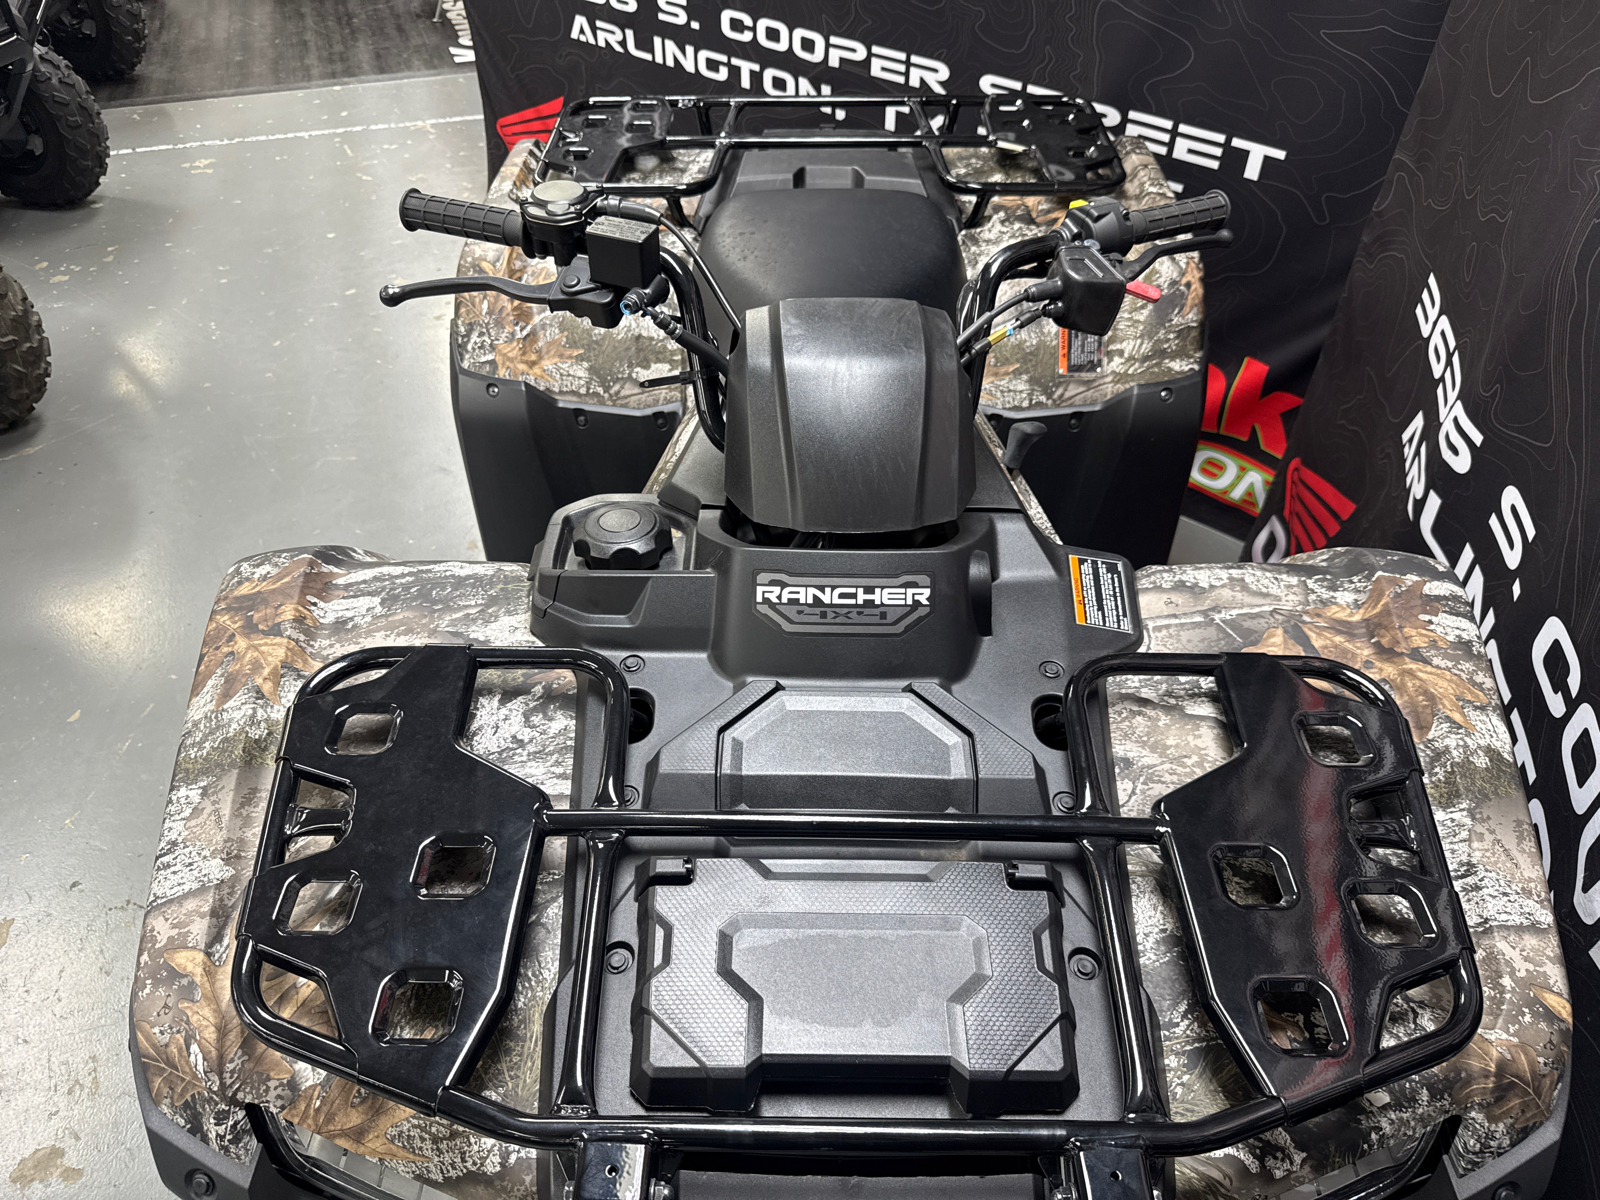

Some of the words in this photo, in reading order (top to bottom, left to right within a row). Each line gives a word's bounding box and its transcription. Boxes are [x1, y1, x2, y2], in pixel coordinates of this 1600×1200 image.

[720, 8, 951, 96] COOPER
[978, 73, 1288, 182] SEET
[1415, 271, 1484, 475] 3636
[1488, 484, 1537, 602] S.
[756, 585, 931, 605] RANCHER
